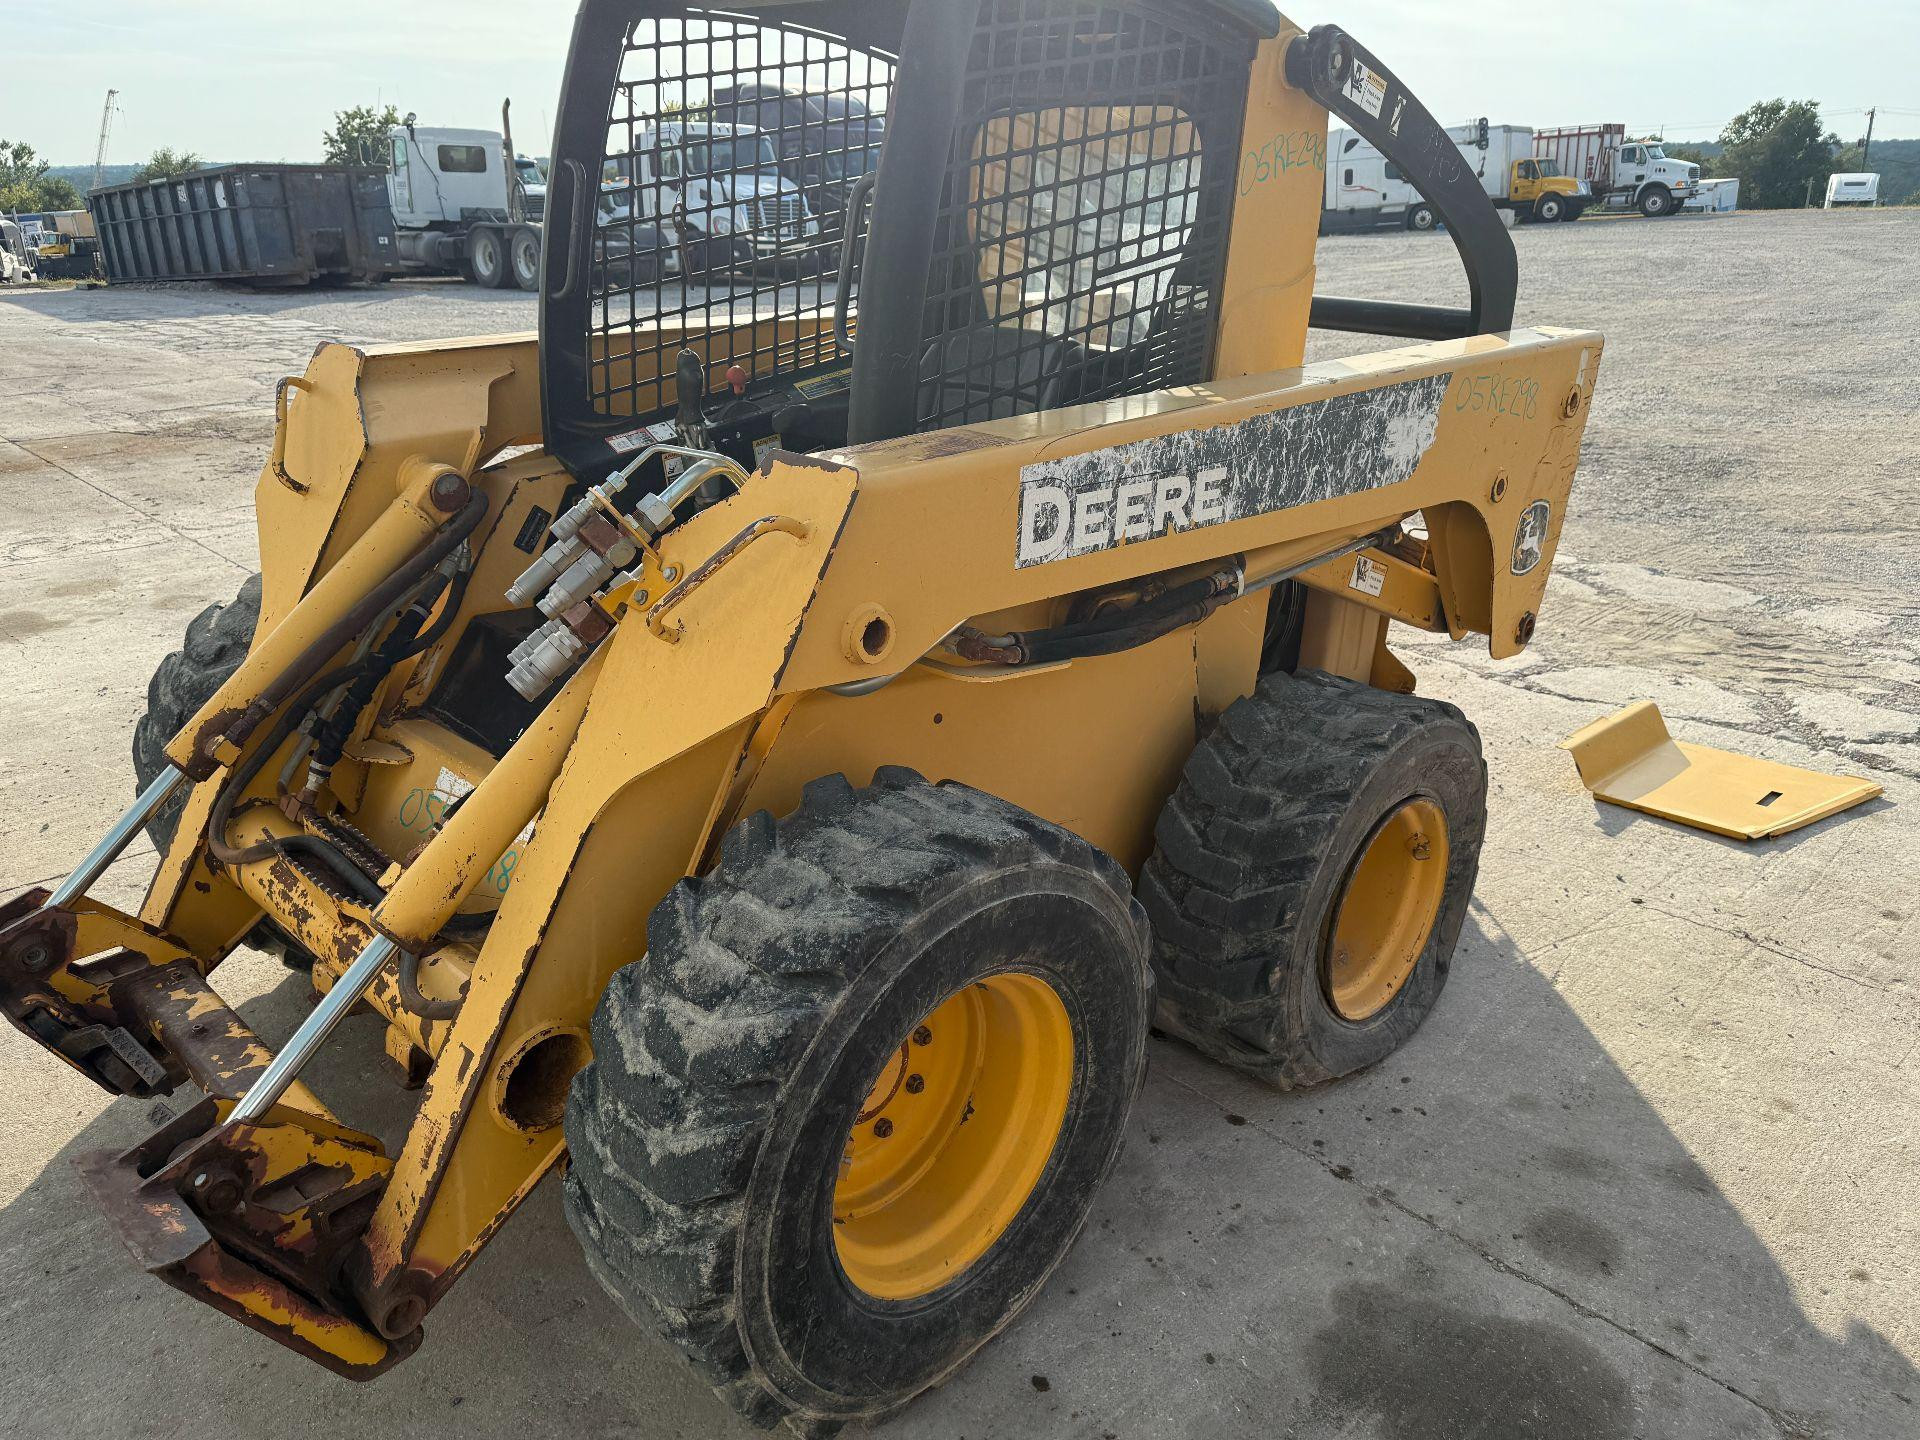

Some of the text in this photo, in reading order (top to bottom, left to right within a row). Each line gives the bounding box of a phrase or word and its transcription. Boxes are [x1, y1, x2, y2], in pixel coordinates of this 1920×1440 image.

[1240, 131, 1325, 198] 05RE298
[1456, 373, 1541, 422] 05RE298
[1022, 467, 1228, 559] DEERE
